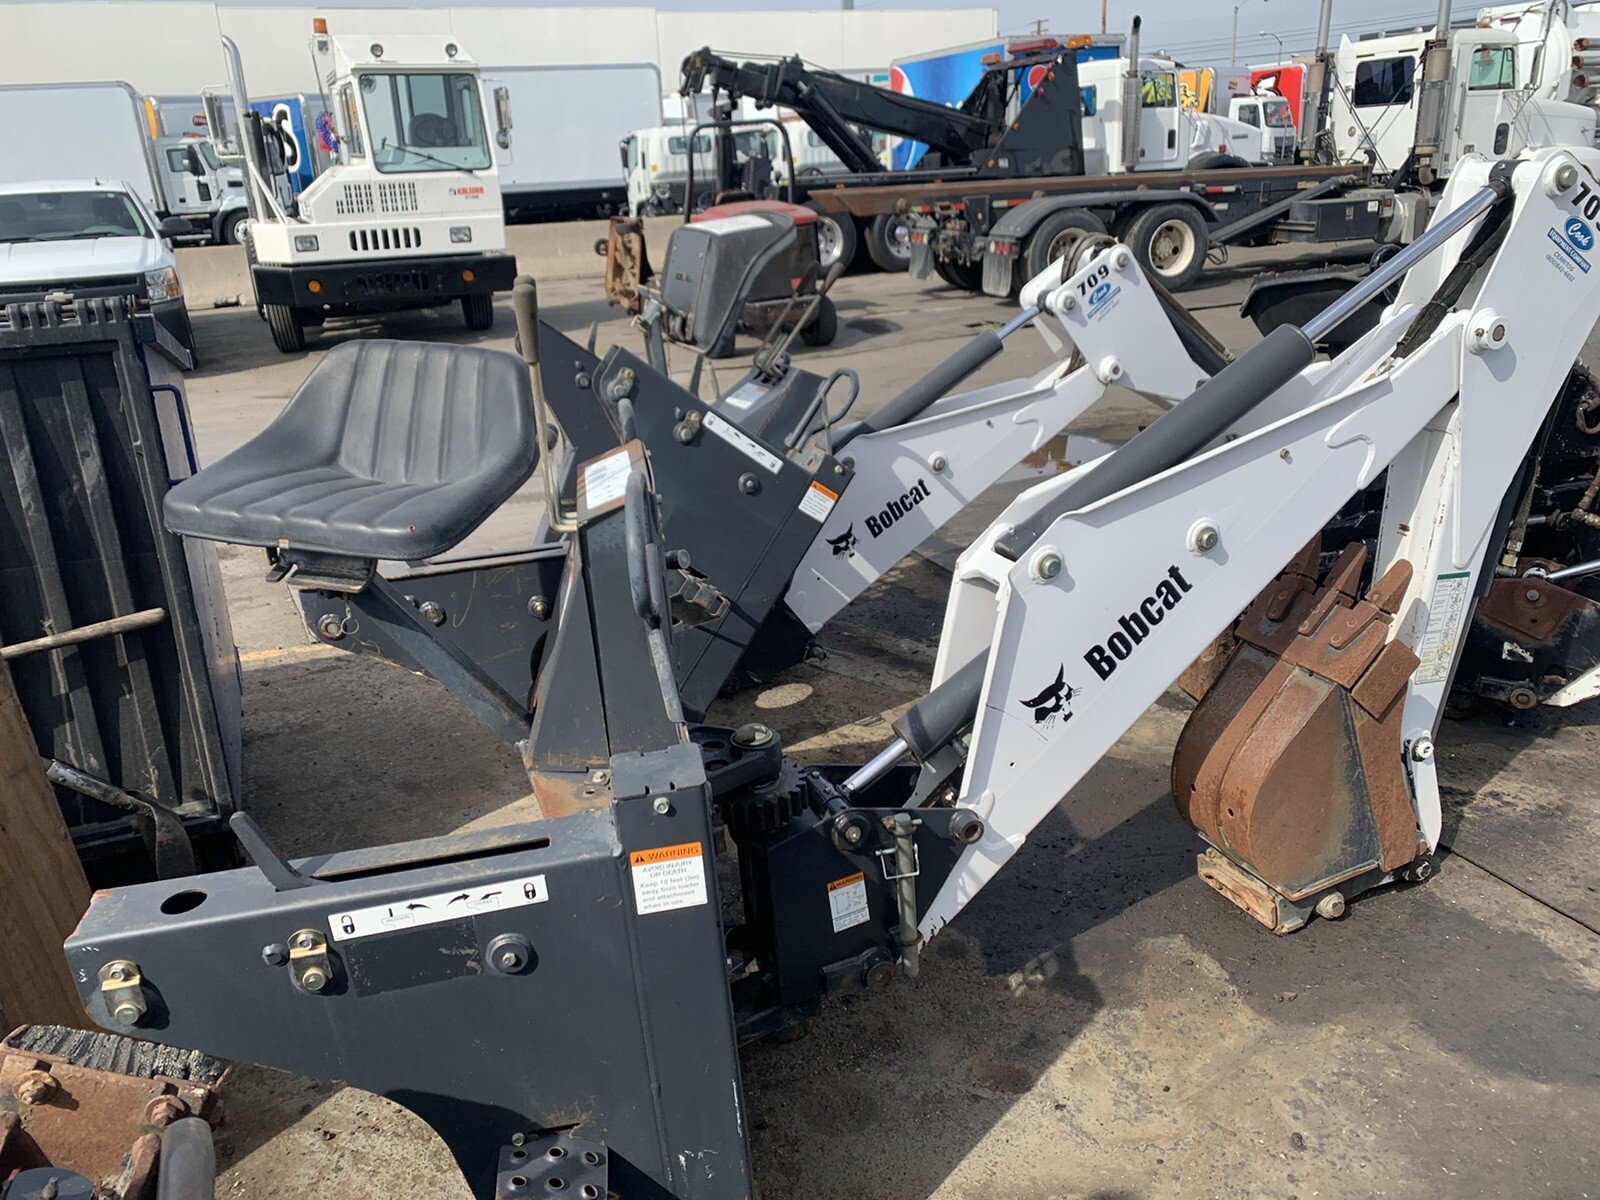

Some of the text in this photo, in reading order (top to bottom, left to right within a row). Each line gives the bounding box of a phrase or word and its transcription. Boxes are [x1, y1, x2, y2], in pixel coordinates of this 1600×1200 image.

[1571, 181, 1600, 232] 70
[1568, 222, 1592, 246] Cook
[1549, 228, 1590, 272] EQUIPMENT COMPANY
[1077, 264, 1109, 296] 709
[864, 477, 931, 539] Bobcat
[1083, 564, 1193, 681] Bobcat
[642, 860, 692, 873] AVOID INJURY
[648, 846, 699, 861] WARNING
[663, 868, 687, 877] DEATH
[657, 890, 695, 901] attachment
